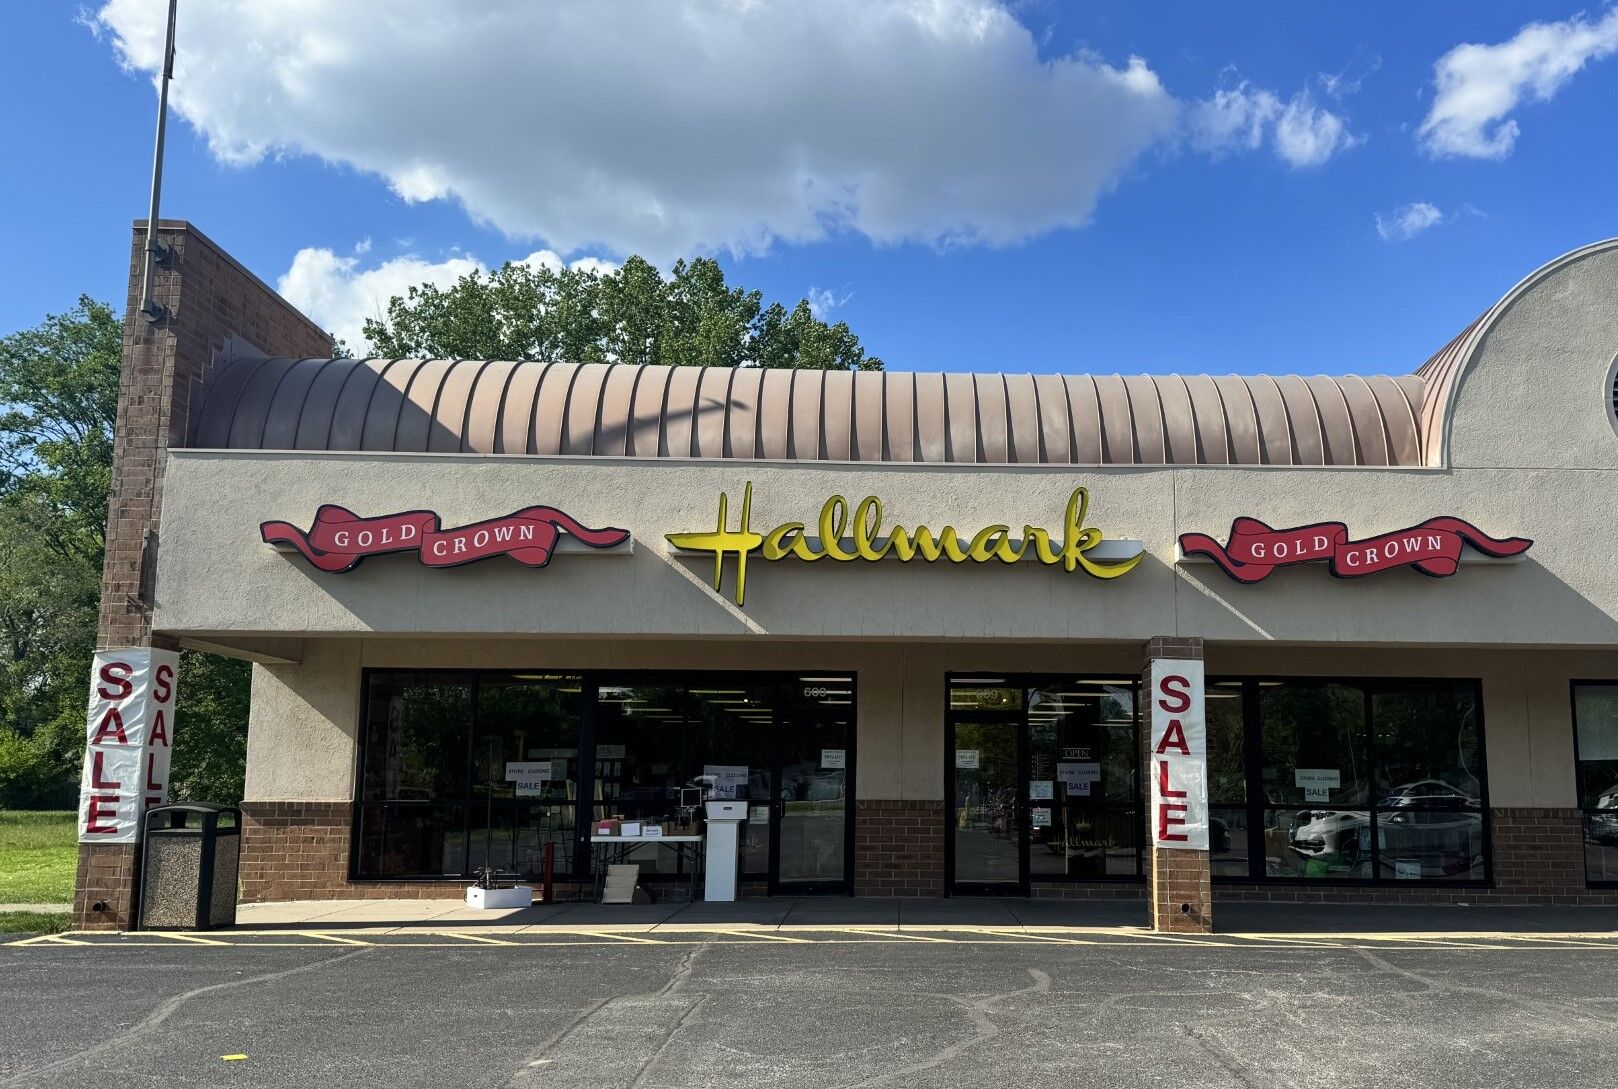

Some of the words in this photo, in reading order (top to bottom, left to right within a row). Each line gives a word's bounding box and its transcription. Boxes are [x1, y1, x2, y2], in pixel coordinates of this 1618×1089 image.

[334, 524, 416, 547] GOLD
[433, 525, 535, 556] CROWN
[664, 481, 1146, 606] Hallmark
[1251, 536, 1329, 558] GOLD
[1346, 536, 1443, 567] CROWN
[87, 662, 134, 833] SALE
[1065, 749, 1090, 758] OPEN
[1156, 675, 1191, 842] SALE
[518, 782, 540, 790] SALE
[714, 785, 735, 793] SALE
[1306, 788, 1327, 796] SALE
[1047, 833, 1119, 853] Hallmark
